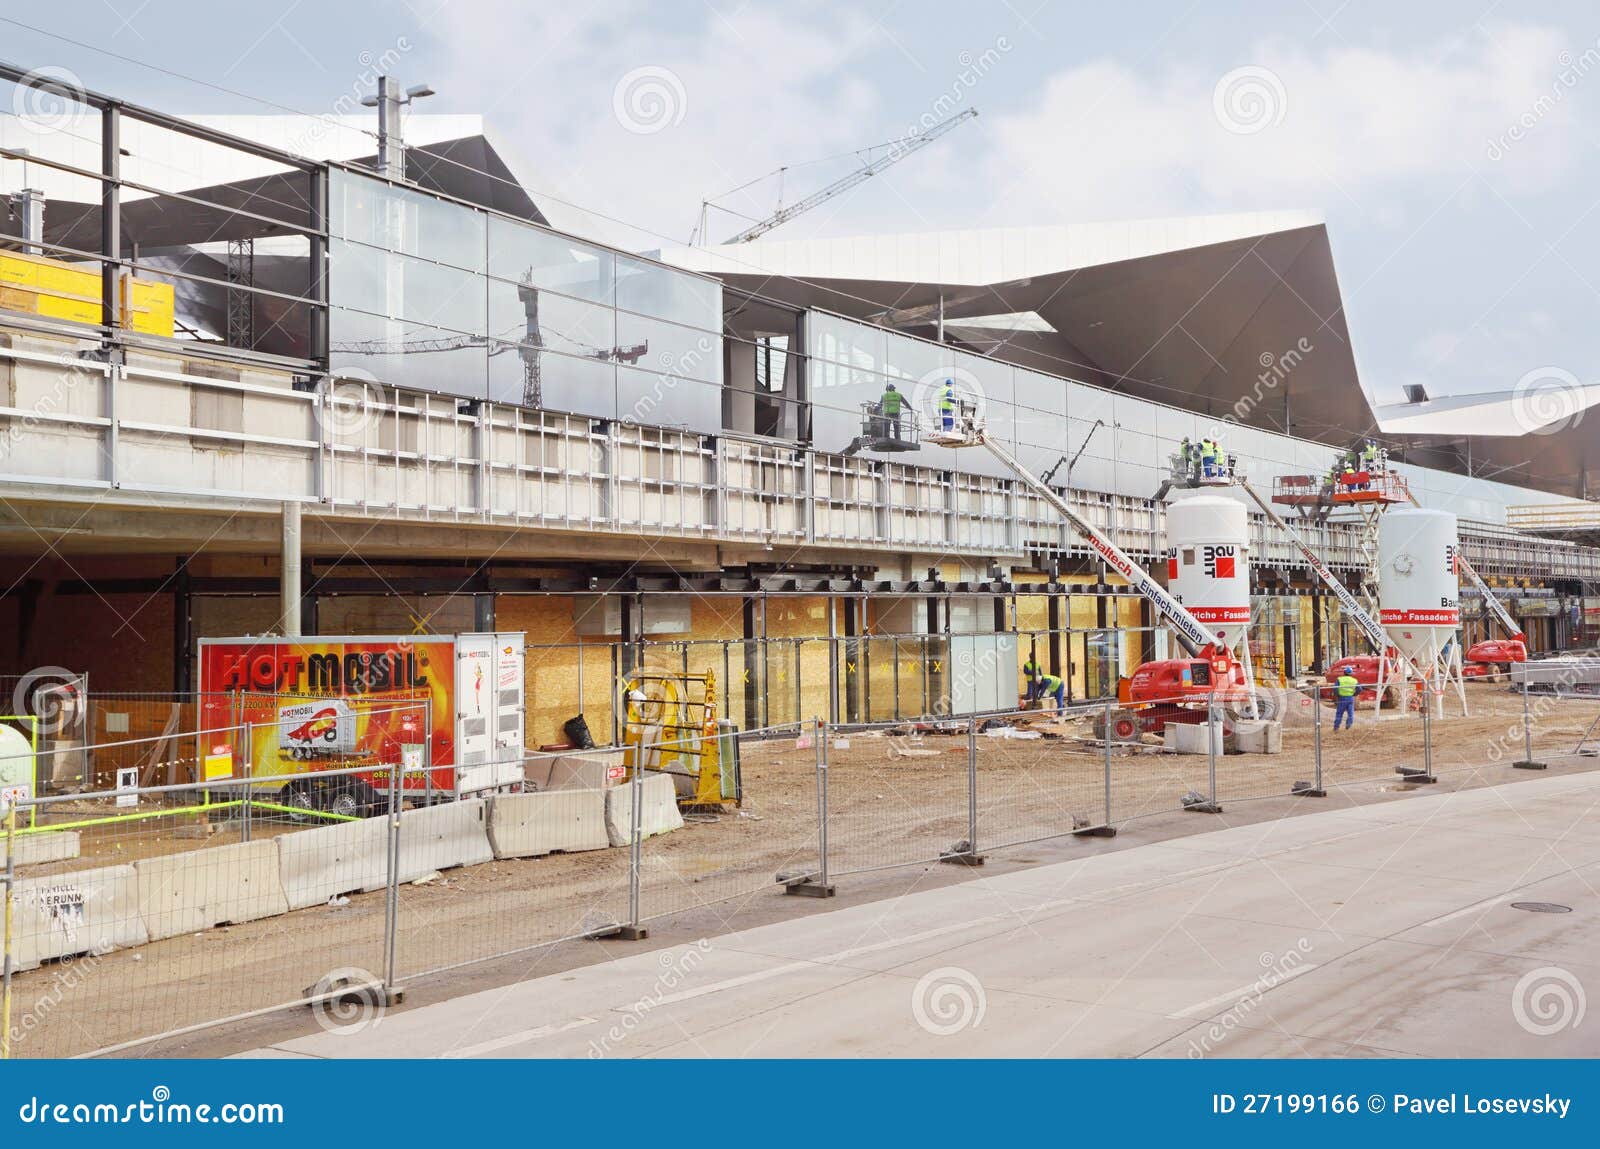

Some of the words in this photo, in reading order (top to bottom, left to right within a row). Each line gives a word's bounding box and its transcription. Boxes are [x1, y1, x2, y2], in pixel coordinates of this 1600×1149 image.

[1089, 534, 1133, 577] maltech
[1140, 579, 1173, 616] Einfach
[1173, 612, 1203, 643] mieten
[1334, 584, 1358, 612] Einfach
[1359, 612, 1381, 638] mieten
[1409, 613, 1449, 621] Fassaden
[222, 652, 429, 692] HOTMOBIL
[281, 706, 314, 718] HOTMOBIL
